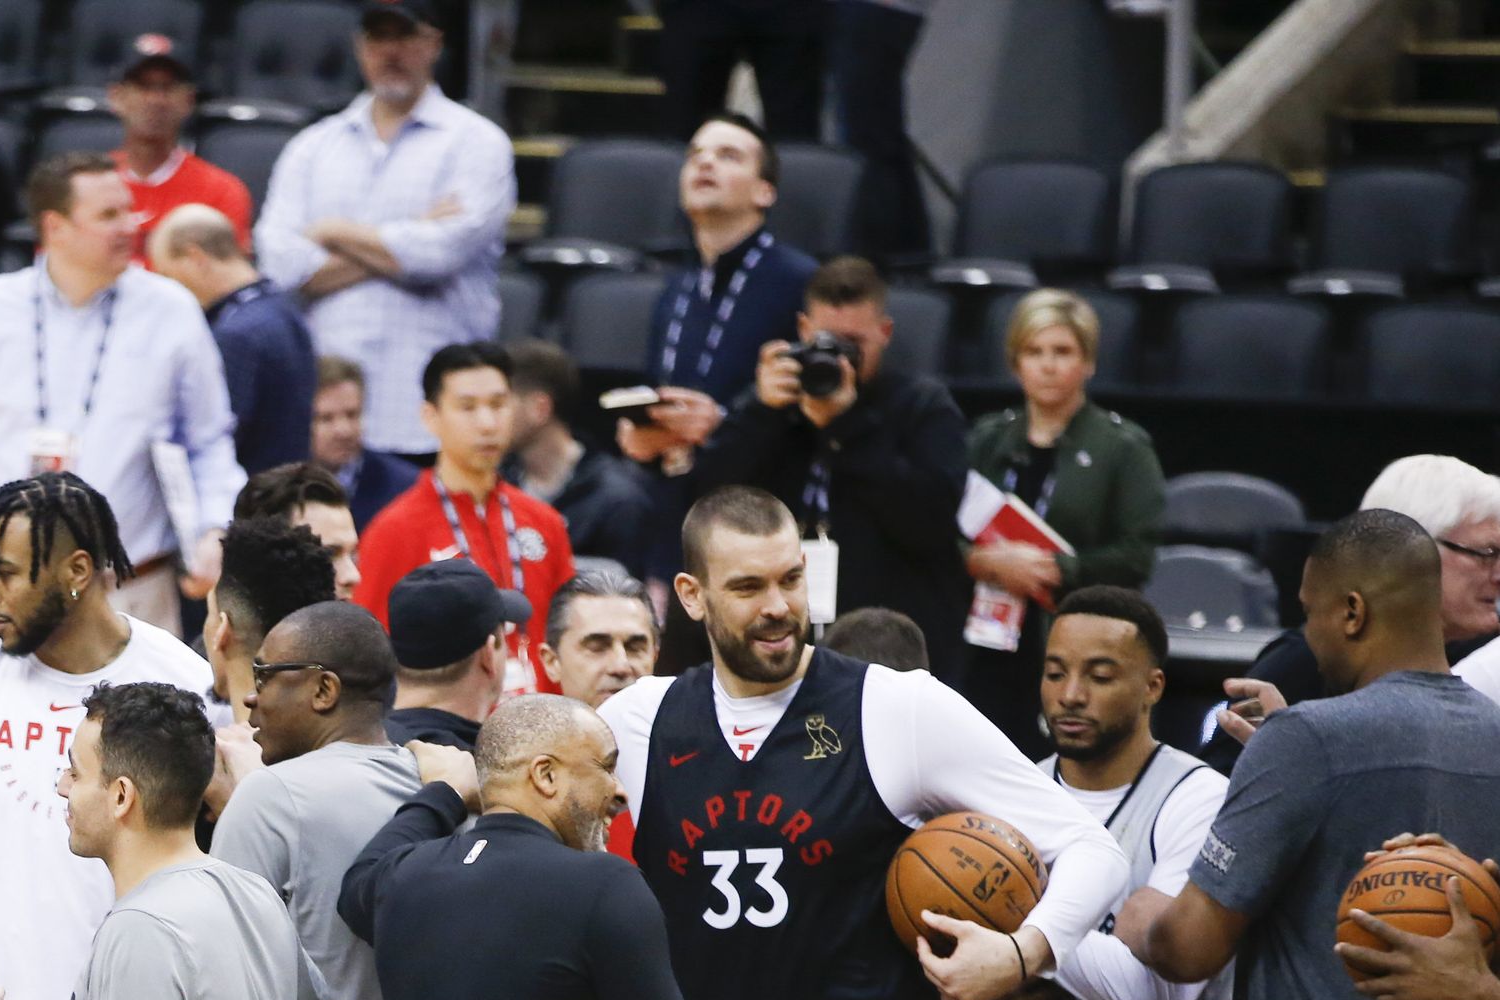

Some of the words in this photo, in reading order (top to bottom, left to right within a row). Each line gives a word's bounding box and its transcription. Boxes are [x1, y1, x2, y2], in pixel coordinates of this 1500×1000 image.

[667, 790, 833, 876] RAPTORS
[702, 847, 789, 930] 33
[1347, 870, 1456, 904] PALDING
